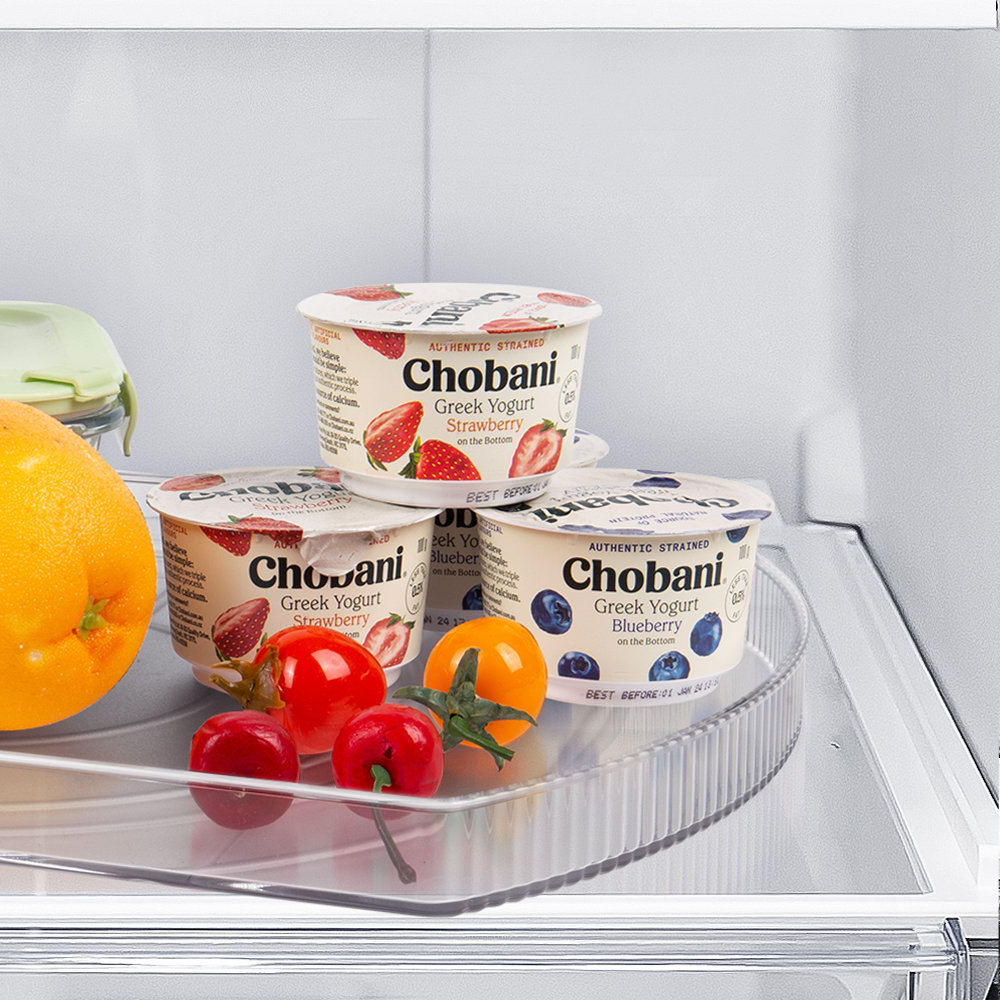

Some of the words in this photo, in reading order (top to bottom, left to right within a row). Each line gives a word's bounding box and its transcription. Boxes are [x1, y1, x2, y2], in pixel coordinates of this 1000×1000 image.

[429, 342, 490, 351] AUTHENTIC
[497, 338, 544, 351] STRAINED
[403, 351, 558, 392] Chobani
[435, 398, 483, 414] Greek
[488, 397, 534, 416] Yogurt
[447, 418, 523, 432] Strawberry
[469, 437, 482, 445] the
[485, 436, 512, 445] Bottom
[466, 490, 499, 503] BEST
[252, 496, 352, 512] Strawberry
[589, 543, 652, 553] AUTHENTIC
[659, 540, 709, 552] STRAINED
[444, 568, 456, 576] the
[563, 552, 724, 593] Chobani
[281, 595, 328, 611] Greek
[334, 592, 381, 612] Yogurt
[594, 598, 644, 614] Greek
[649, 598, 699, 617] Yogurt
[612, 618, 682, 634] Blueberry
[645, 637, 675, 645] Bottom
[586, 689, 615, 700] BEST
